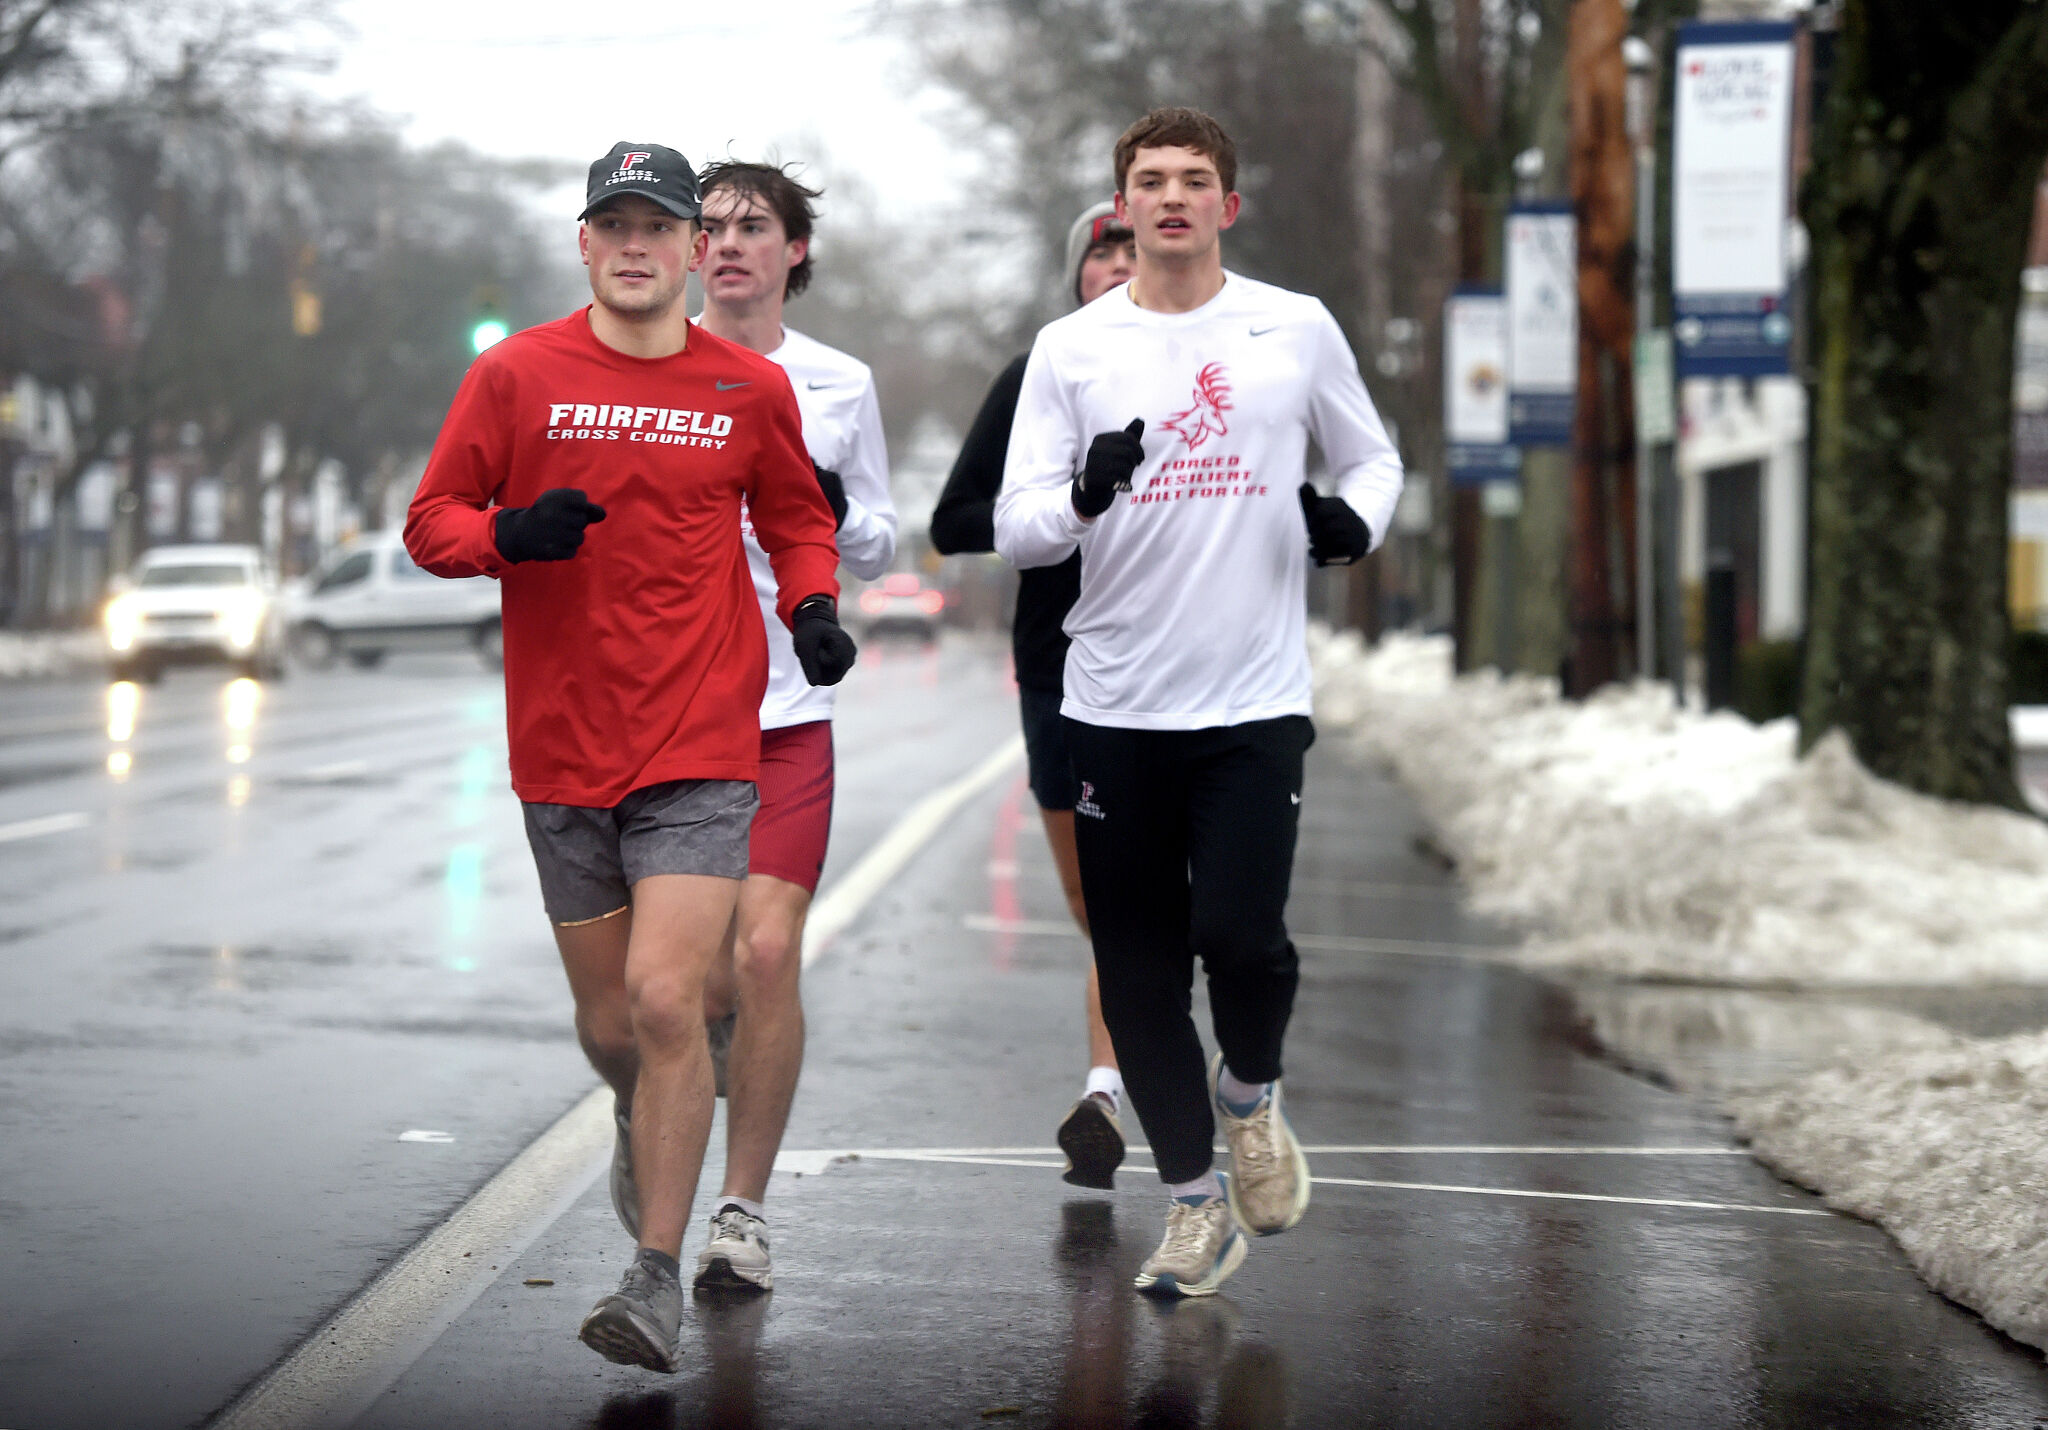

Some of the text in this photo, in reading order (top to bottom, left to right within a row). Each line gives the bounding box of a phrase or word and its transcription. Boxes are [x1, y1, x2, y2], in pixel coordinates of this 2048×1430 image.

[620, 152, 652, 171] F
[605, 175, 661, 186] COUNTRY
[612, 170, 654, 179] CROSS
[548, 403, 734, 437] FAIRFIELD
[547, 428, 727, 450] CROSS COUNTRY
[1161, 455, 1240, 472] FORGED
[1149, 471, 1252, 489] RESILIENT
[1130, 485, 1269, 505] BUILT FOR LIFE
